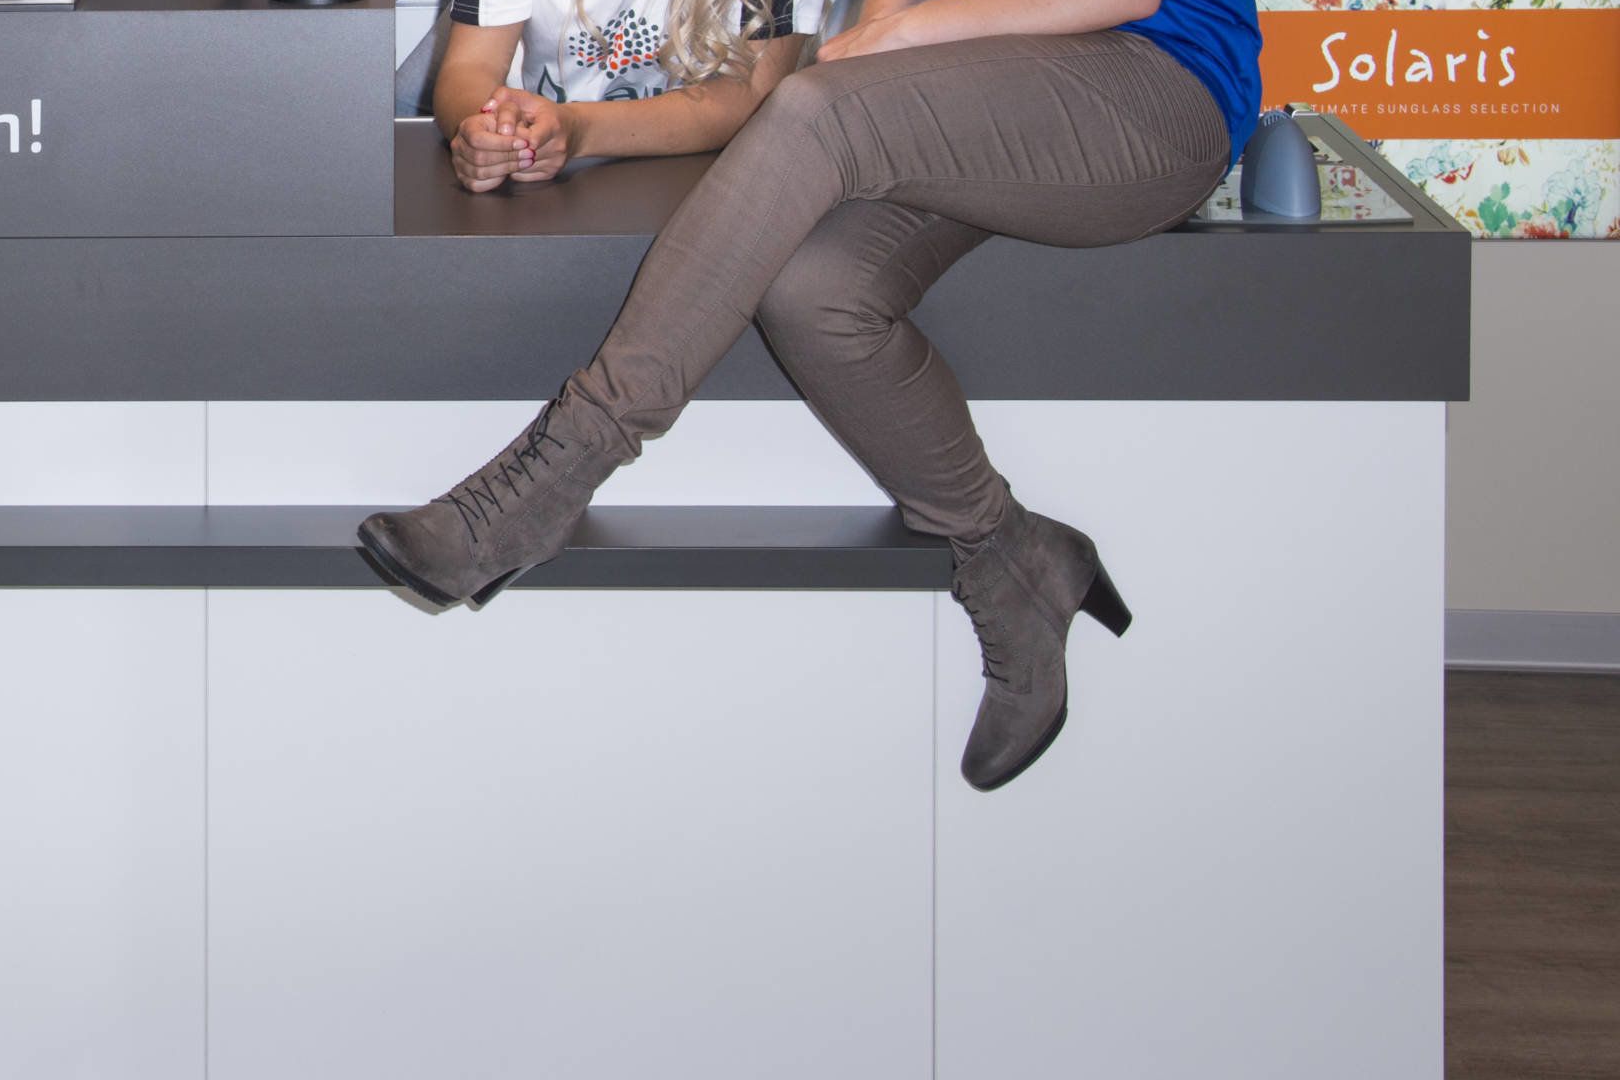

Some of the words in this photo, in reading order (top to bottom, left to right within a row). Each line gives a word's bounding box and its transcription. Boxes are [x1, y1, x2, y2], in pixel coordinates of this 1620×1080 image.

[1312, 28, 1516, 93] Solaris
[1376, 103, 1462, 115] SUNGLASS
[1470, 103, 1562, 115] SELECTION
